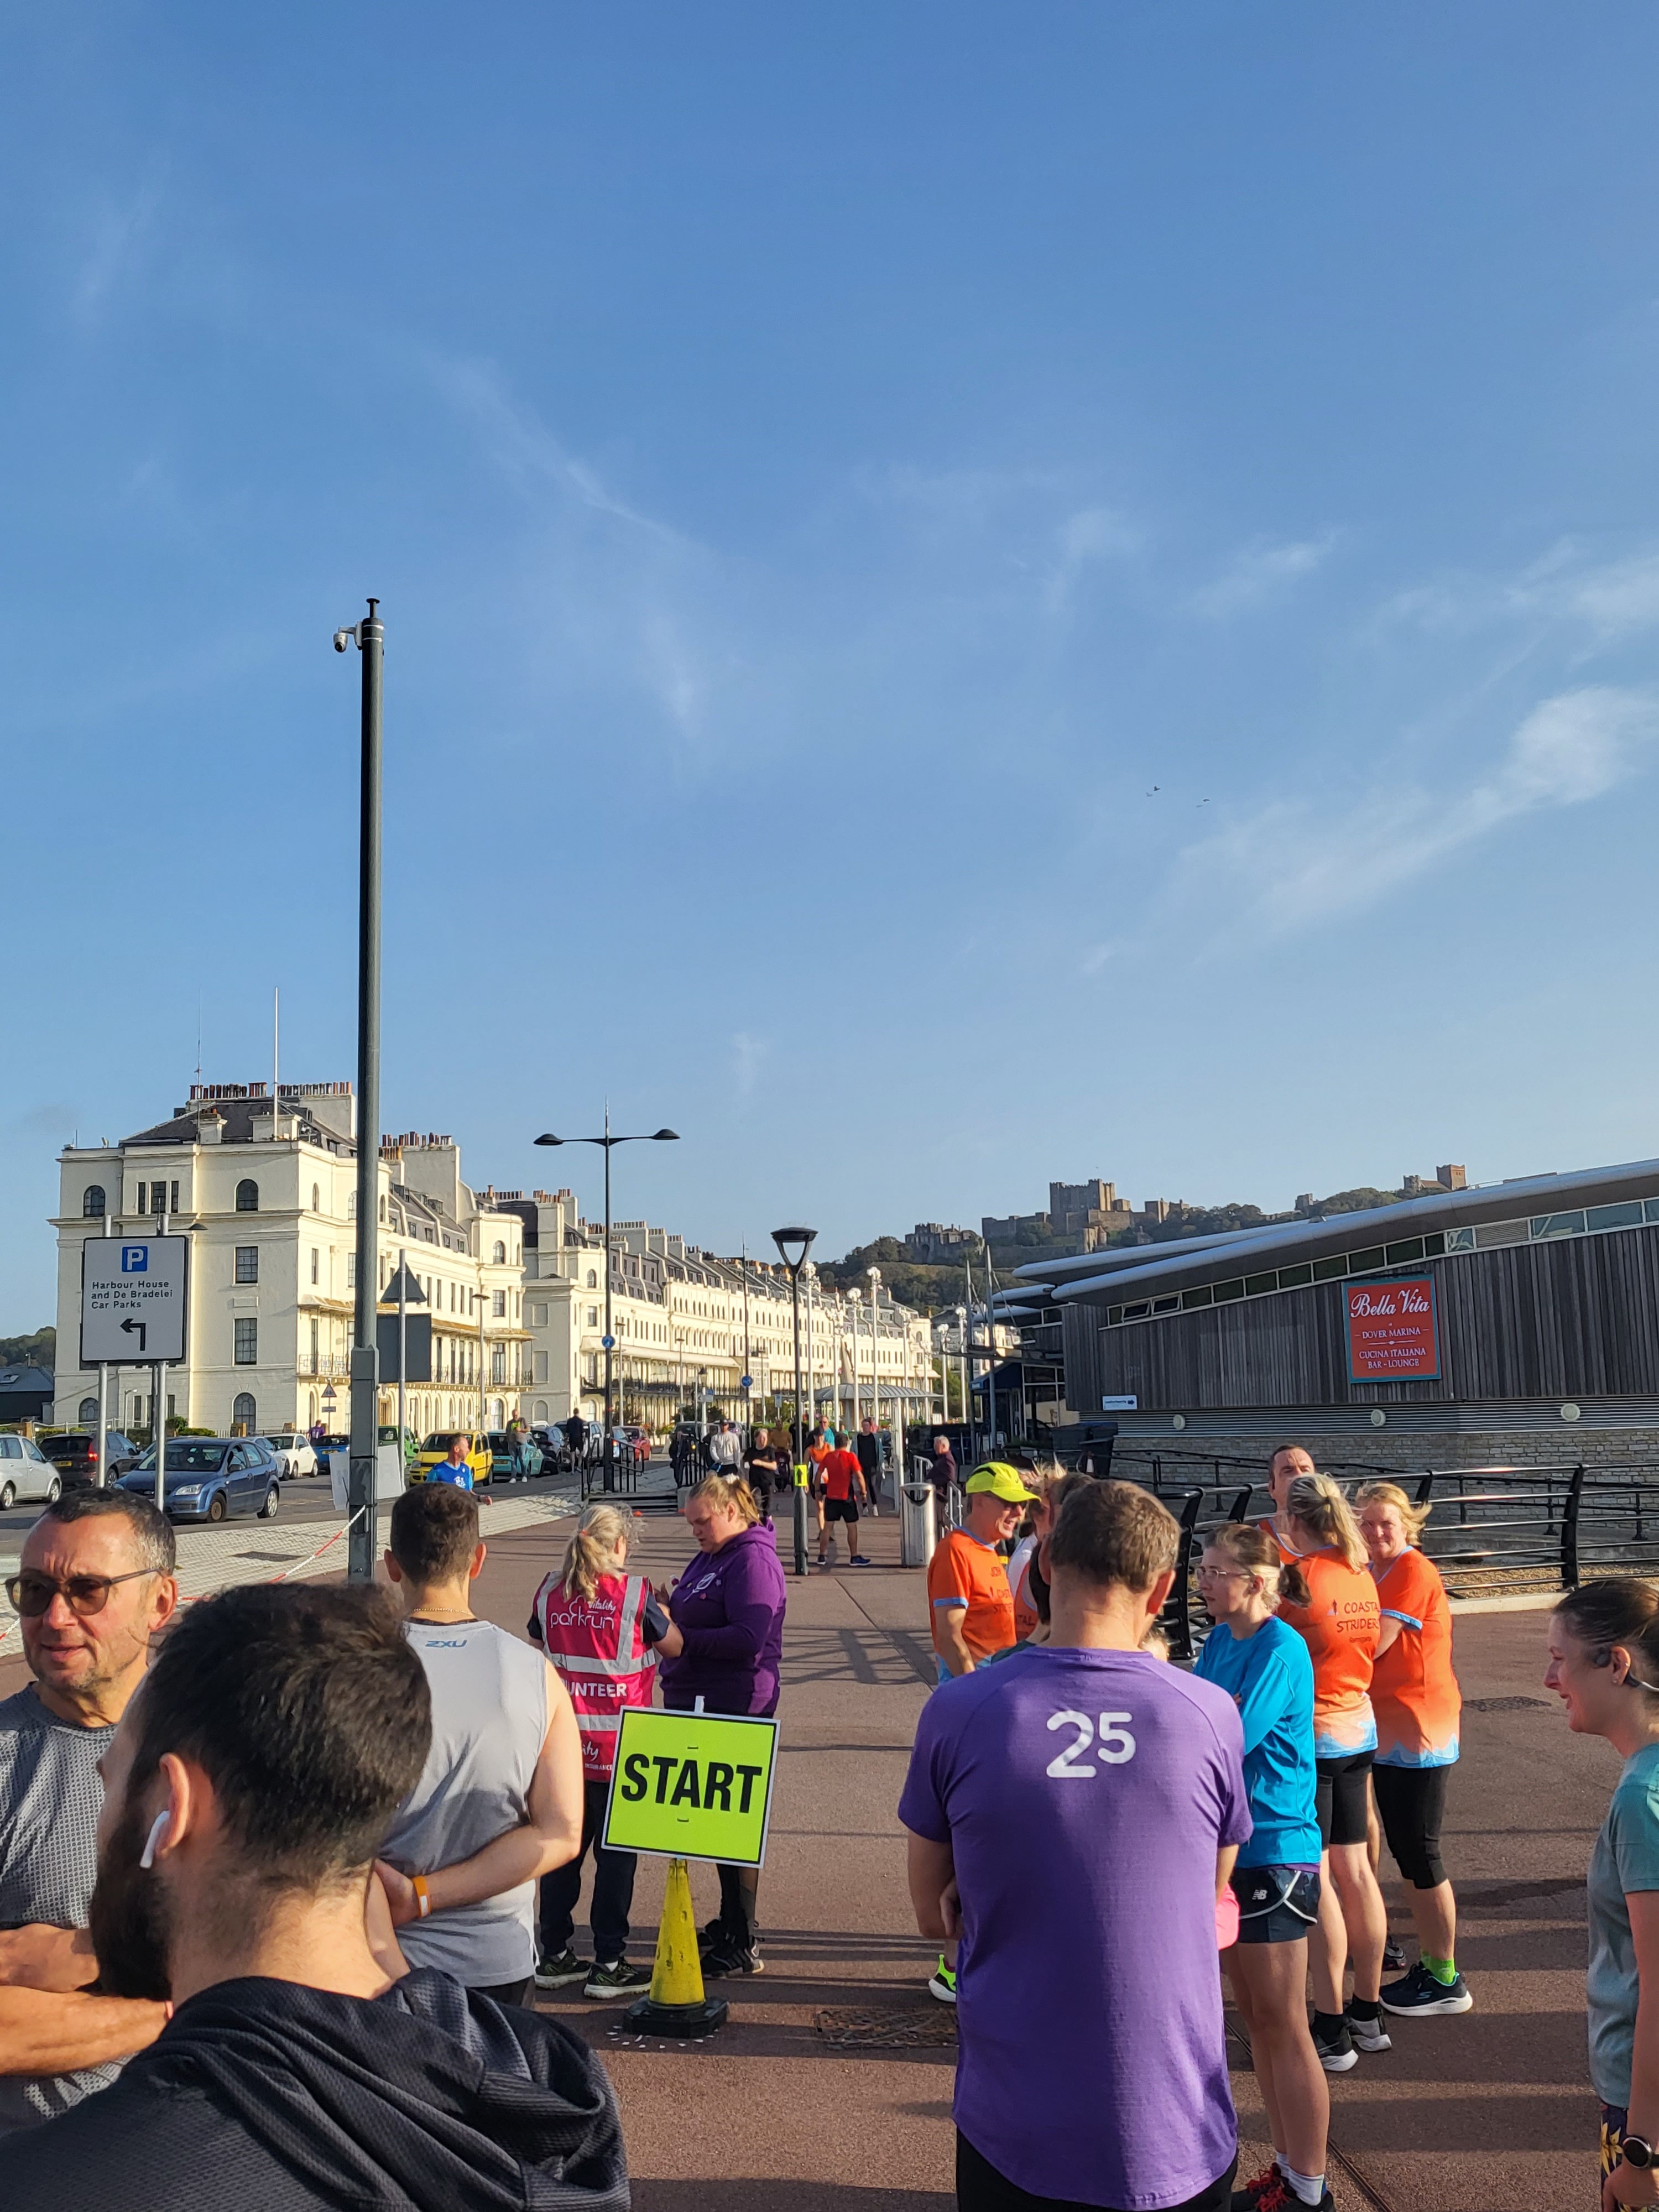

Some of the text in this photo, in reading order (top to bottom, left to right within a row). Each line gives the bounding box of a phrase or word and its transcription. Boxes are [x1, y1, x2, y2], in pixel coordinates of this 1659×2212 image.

[127, 1248, 144, 1270] P
[91, 1289, 173, 1299] and De Bradelei
[113, 1300, 141, 1308] Parks
[1350, 1288, 1430, 1318] Bella Vita
[1362, 1327, 1421, 1339] DOVER MARINA
[1359, 1347, 1426, 1359] CUCINA ITALIANA
[1368, 1361, 1382, 1369] BAR
[1388, 1358, 1420, 1368] LOUNGE
[1344, 1601, 1381, 1614] COASTA
[550, 1604, 614, 1630] parkrun
[425, 1640, 467, 1648] 2XU
[561, 1679, 627, 1697] UNTEER
[1046, 1710, 1136, 1777] 25
[621, 1753, 763, 1814] START
